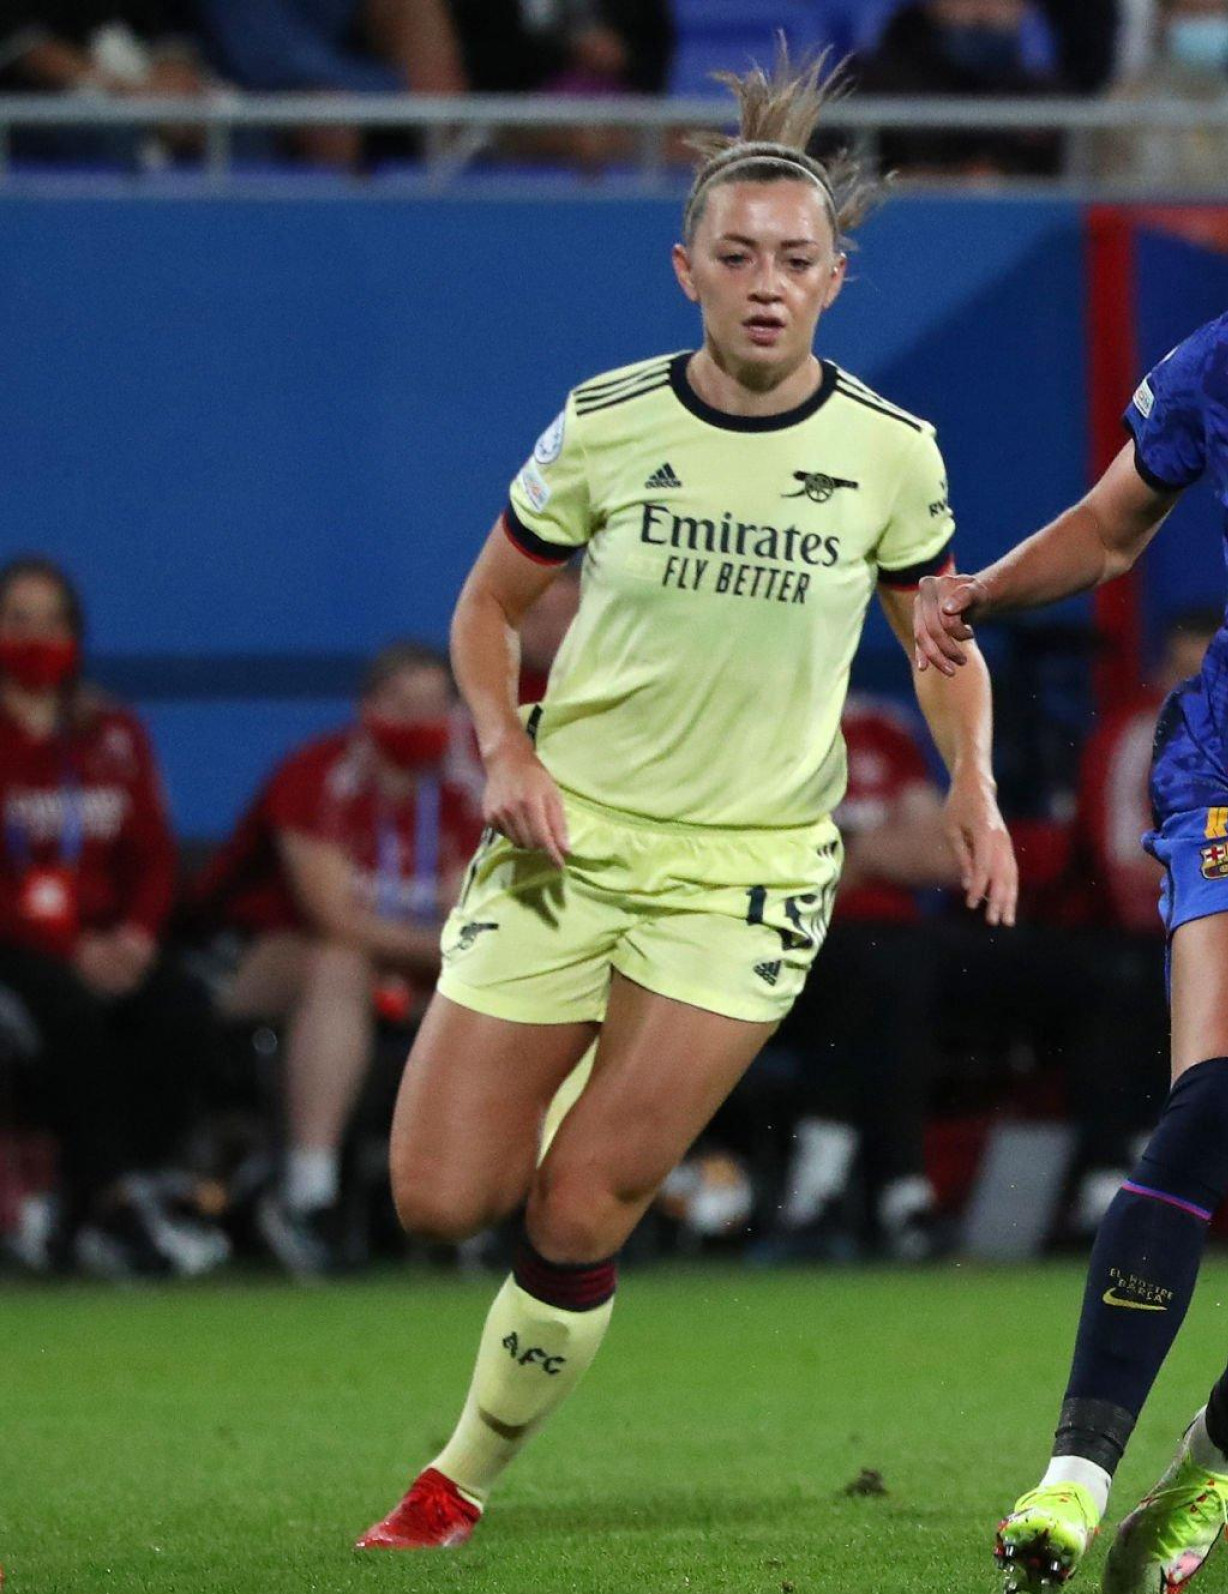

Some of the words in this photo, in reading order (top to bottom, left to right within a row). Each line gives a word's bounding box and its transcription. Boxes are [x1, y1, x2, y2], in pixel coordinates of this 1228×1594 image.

[640, 502, 841, 568] Emirates
[661, 555, 709, 591] FLY
[715, 561, 811, 605] BETTER
[502, 1331, 566, 1375] AFC
